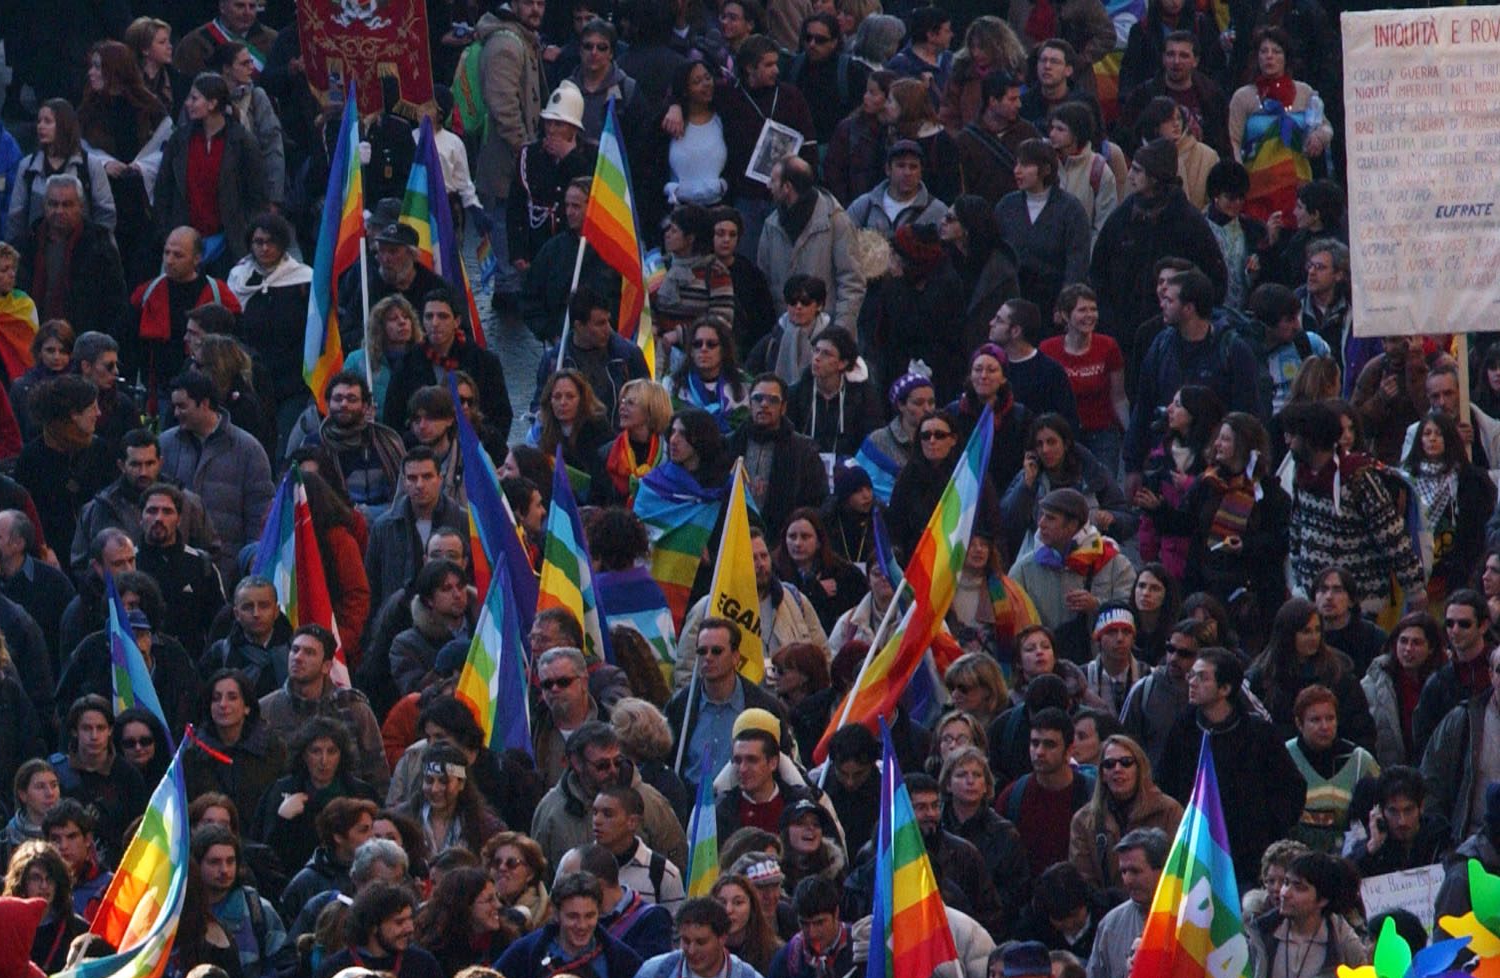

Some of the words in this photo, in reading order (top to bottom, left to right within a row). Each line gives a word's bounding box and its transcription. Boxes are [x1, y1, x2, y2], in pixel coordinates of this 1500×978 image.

[1374, 16, 1439, 48] INIQUITÀ
[1451, 20, 1460, 44] E
[1400, 65, 1440, 79] GUERRA
[1435, 203, 1494, 218] EUFRATE
